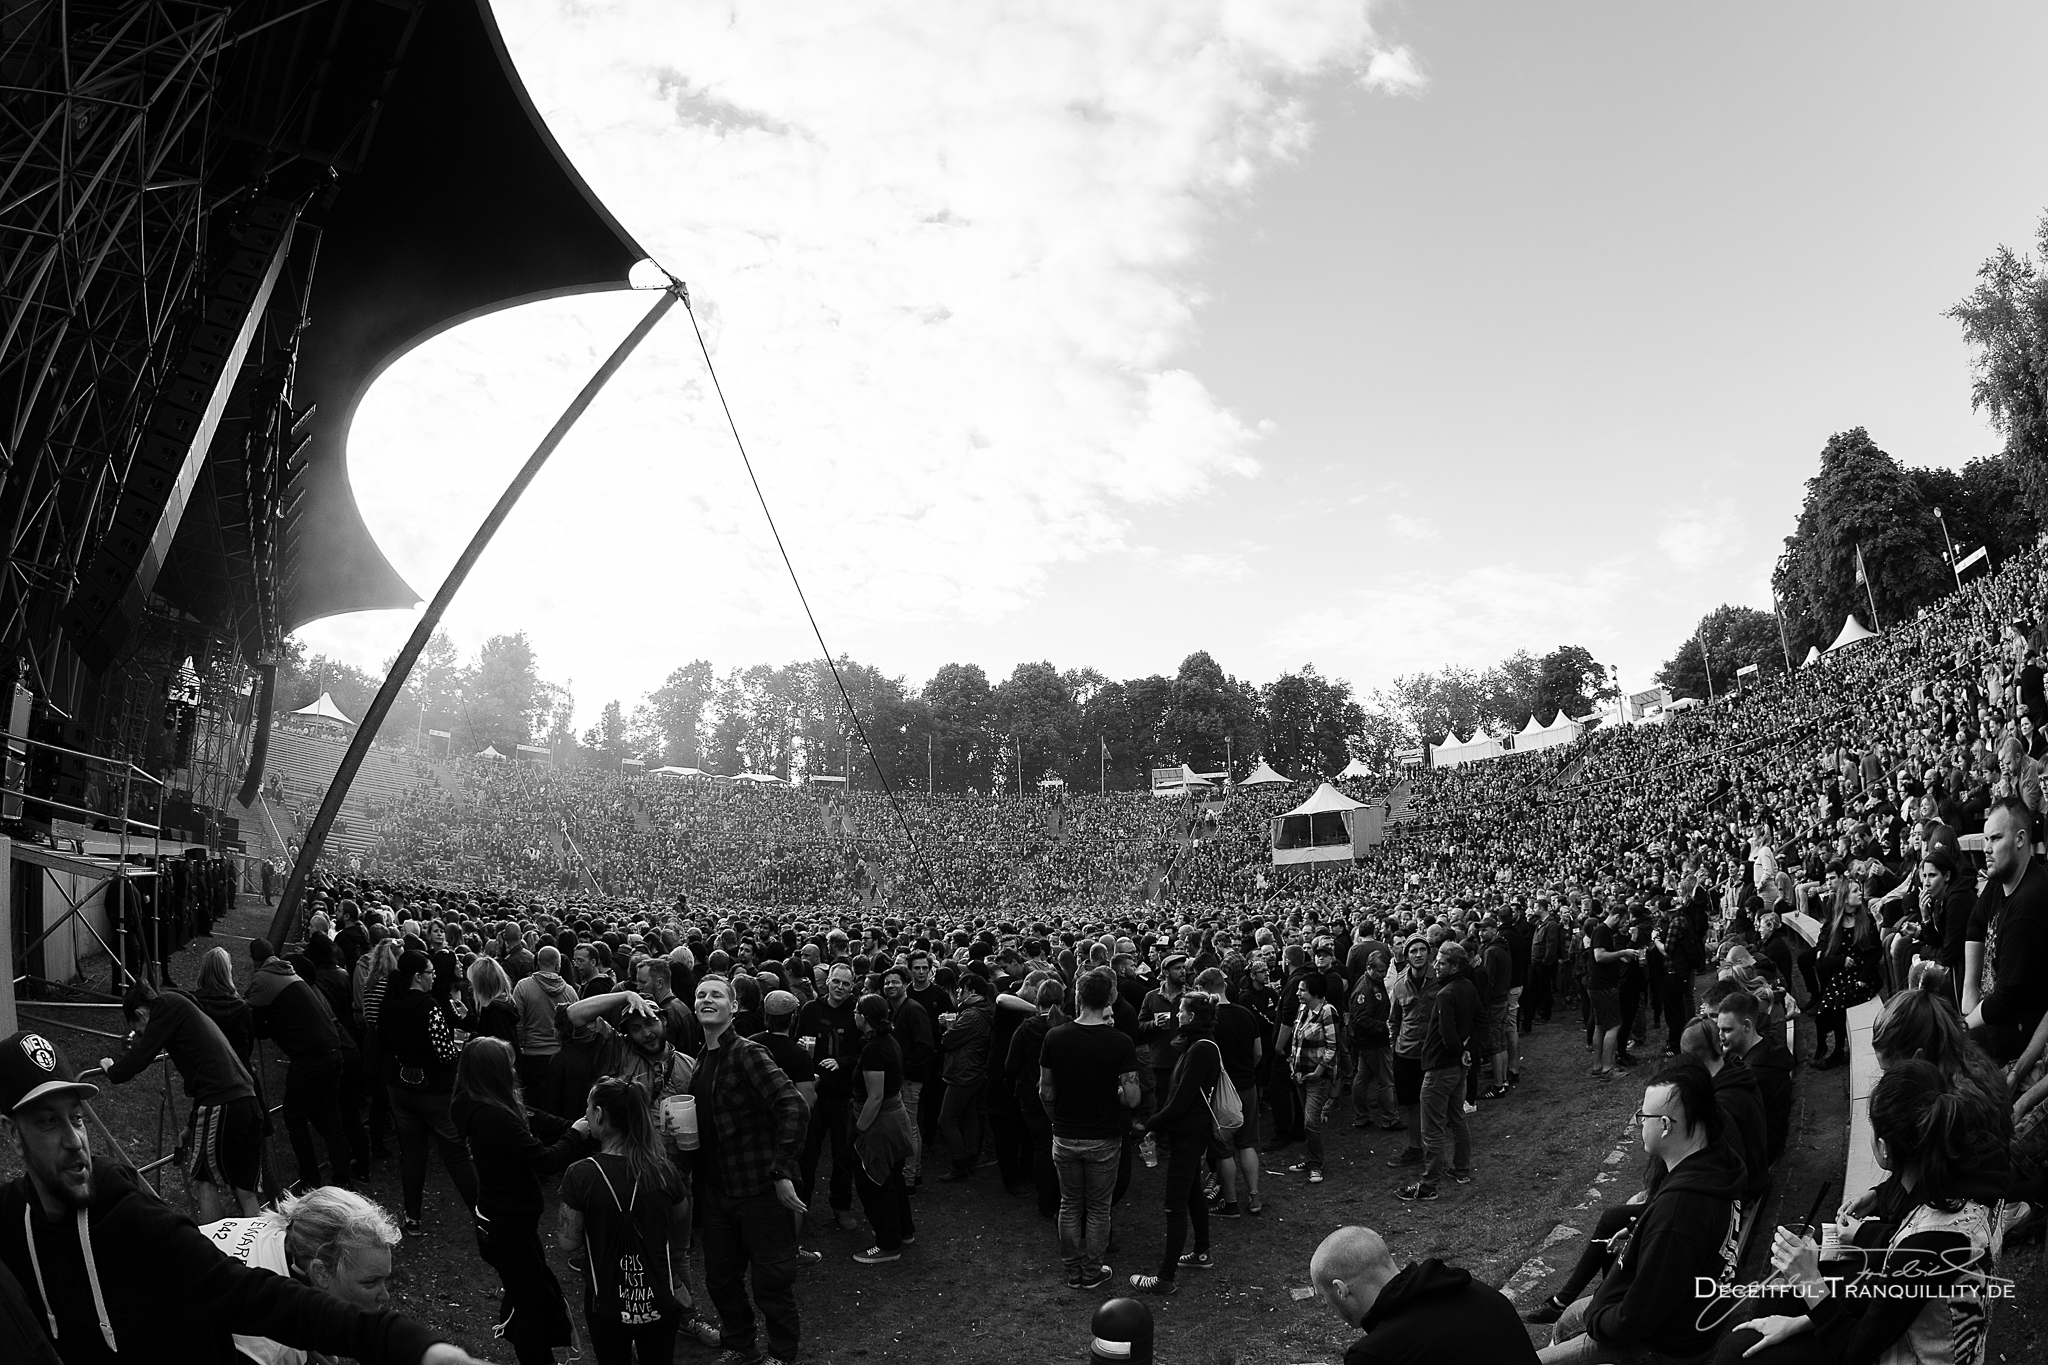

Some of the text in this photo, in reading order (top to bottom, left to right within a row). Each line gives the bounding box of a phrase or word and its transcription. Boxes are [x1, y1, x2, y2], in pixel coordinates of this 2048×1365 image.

[22, 1034, 53, 1055] NETS
[212, 1221, 238, 1240] 642
[619, 1285, 655, 1301] WANNA
[625, 1300, 653, 1313] HAVE
[621, 1310, 661, 1325] BASS
